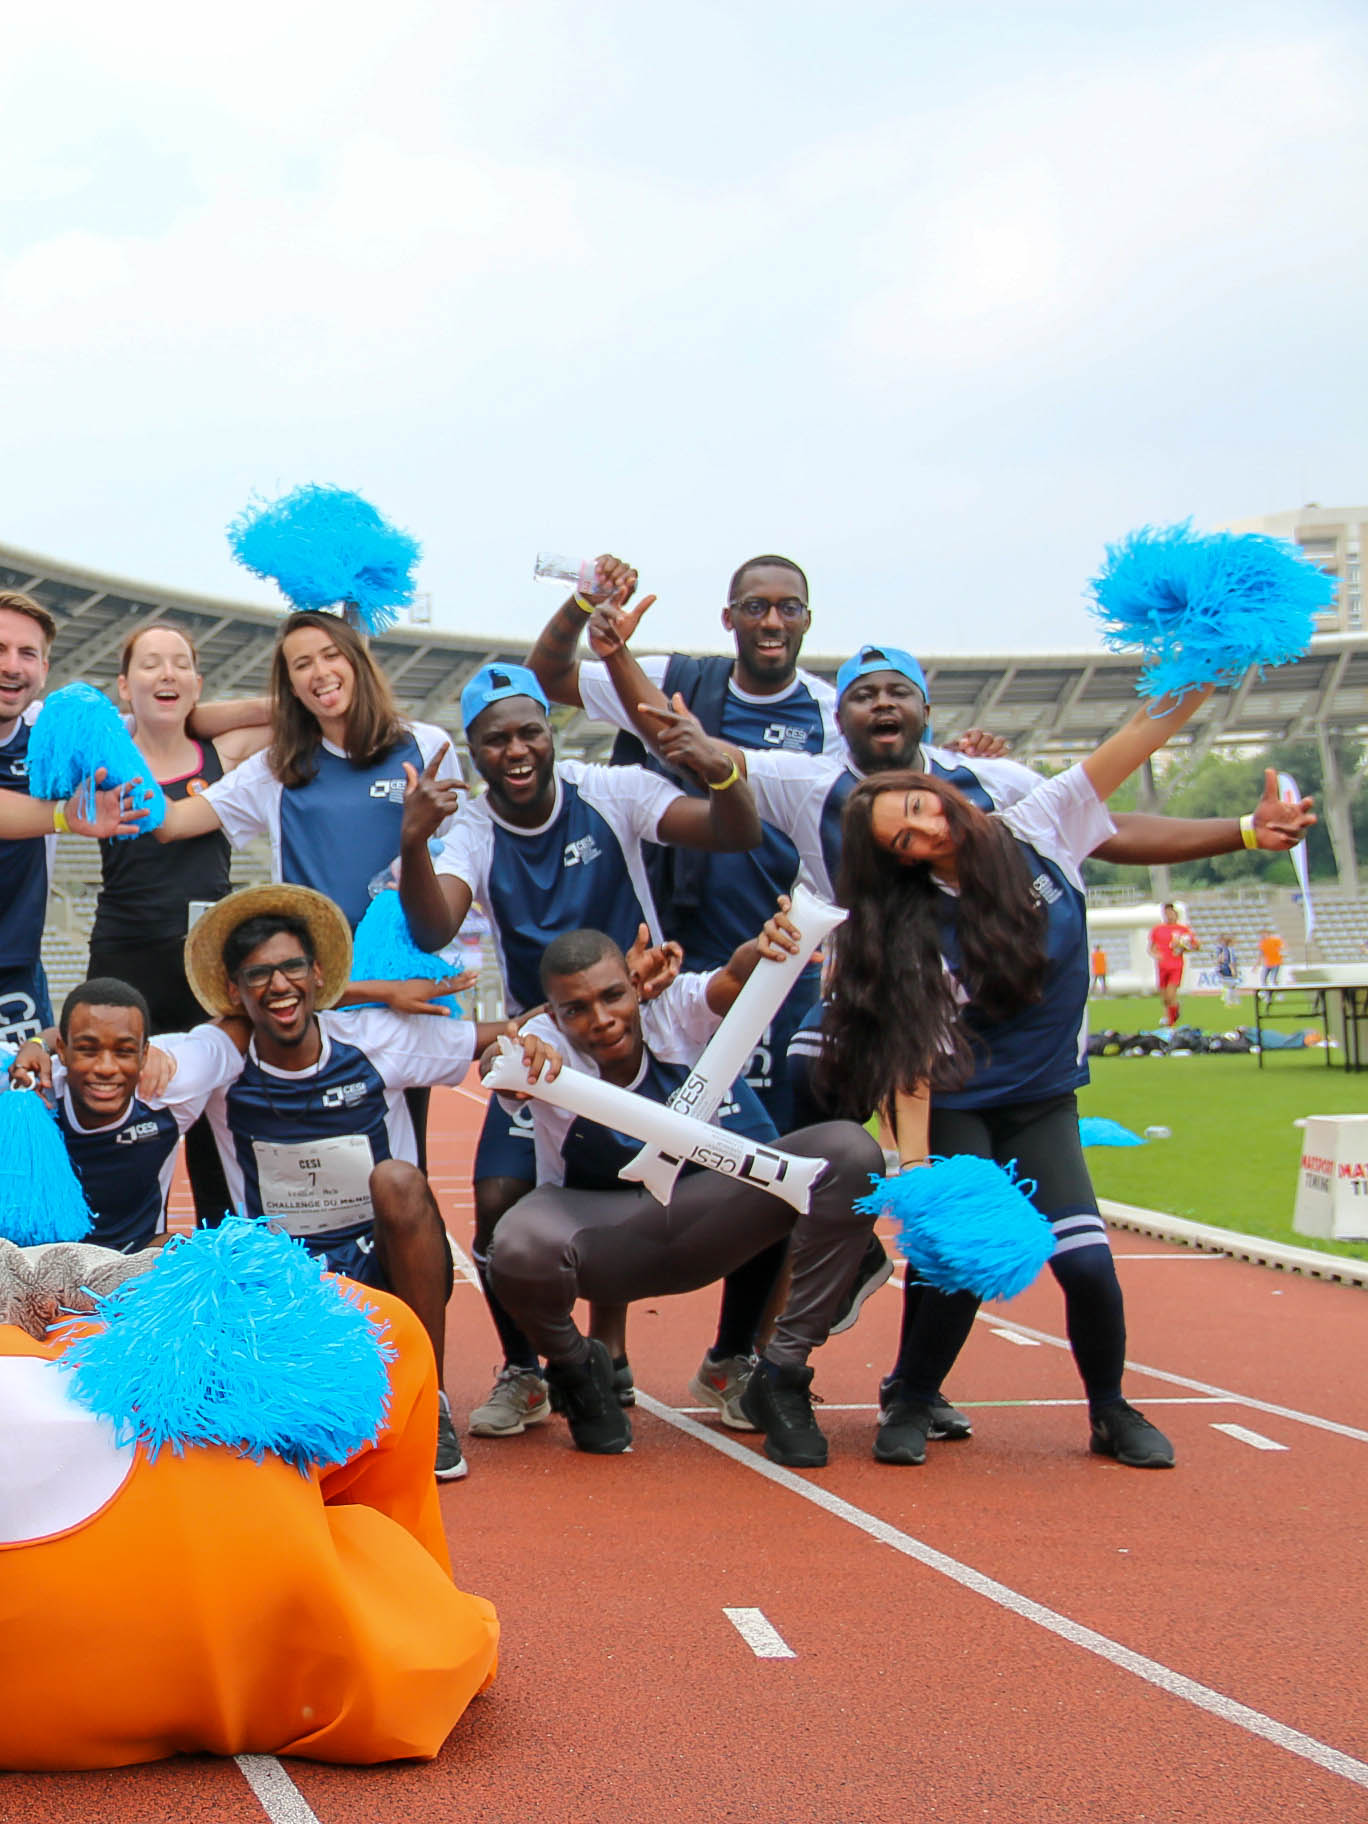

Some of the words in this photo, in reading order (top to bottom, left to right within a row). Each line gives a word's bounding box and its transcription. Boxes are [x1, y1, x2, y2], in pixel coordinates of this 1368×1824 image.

[673, 1073, 708, 1116] CESI
[690, 1145, 736, 1173] CESI
[308, 1172, 316, 1187] 7
[266, 1200, 320, 1209] CHALLENGE
[323, 1199, 338, 1208] DU
